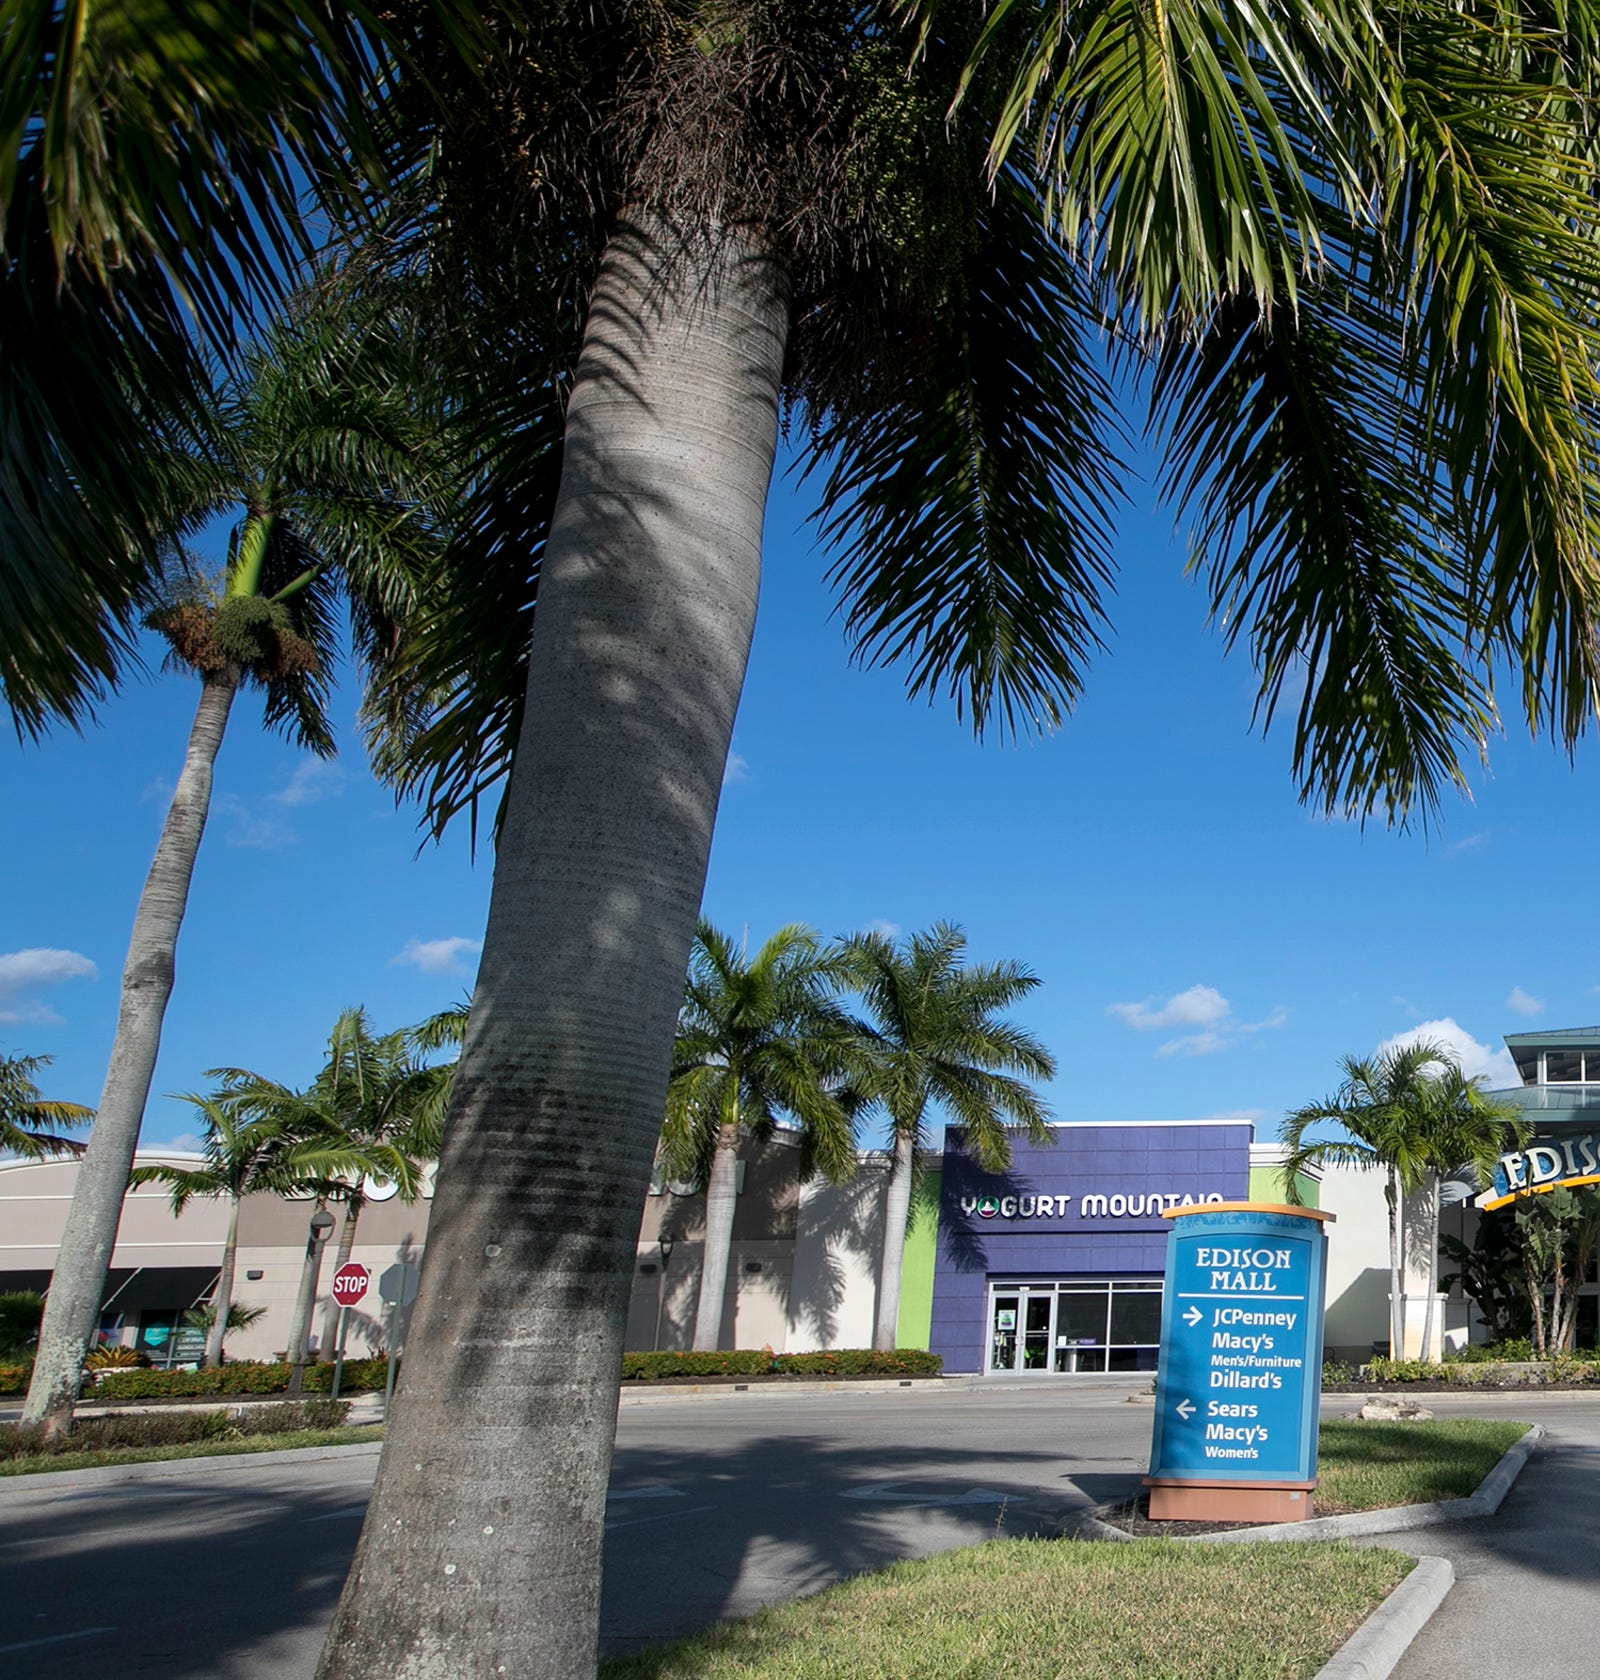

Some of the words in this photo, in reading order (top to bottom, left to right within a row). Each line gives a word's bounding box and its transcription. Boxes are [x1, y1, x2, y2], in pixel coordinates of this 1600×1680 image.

[961, 1195, 1071, 1219] YOGURT
[1196, 1248, 1291, 1269] EDISON
[334, 1276, 368, 1293] STOP
[1210, 1271, 1277, 1291] MALL
[1212, 1308, 1297, 1330] JCPenney
[1212, 1332, 1274, 1353] Macy's
[1210, 1355, 1302, 1367] Men's/Furniture
[1210, 1369, 1282, 1389] Dillard's
[1207, 1400, 1258, 1417] Sears
[1205, 1424, 1268, 1445] Macy's
[1205, 1446, 1259, 1459] Women's
